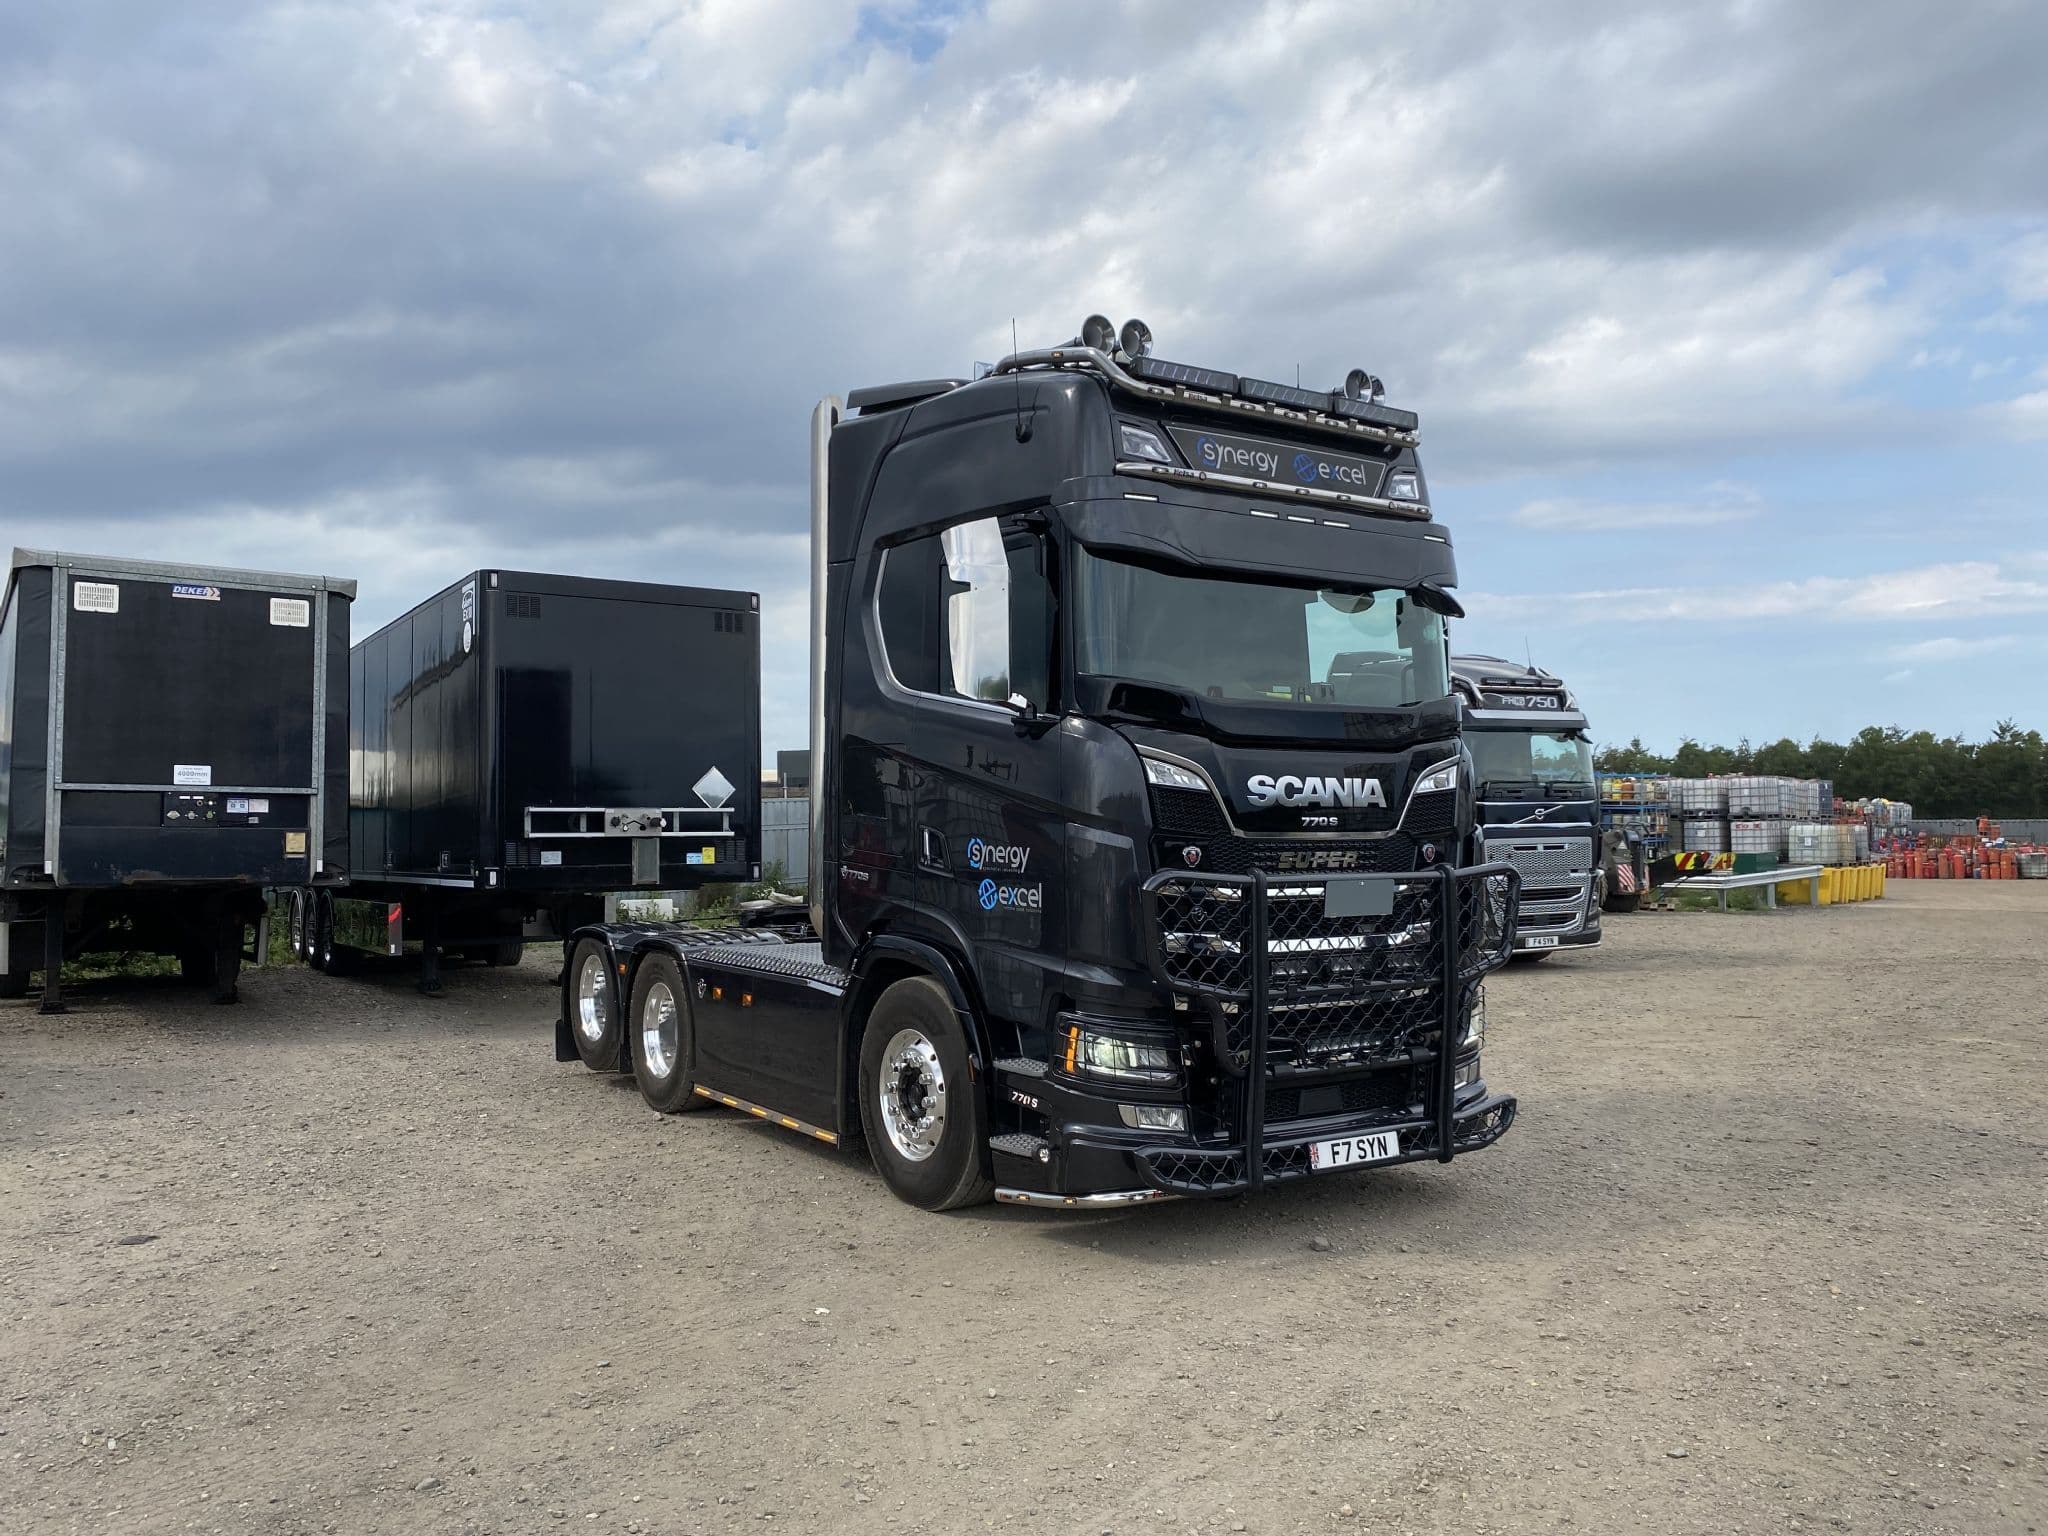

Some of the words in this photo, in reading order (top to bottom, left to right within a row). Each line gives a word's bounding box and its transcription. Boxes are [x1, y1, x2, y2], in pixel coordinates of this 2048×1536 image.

[1203, 441, 1279, 478] synergy
[1318, 461, 1368, 486] excel
[1526, 695, 1558, 709] 750
[1247, 774, 1388, 808] SCANIA
[971, 843, 1031, 874] synergy
[1278, 851, 1359, 869] SUPER
[998, 882, 1042, 908] excel
[1330, 1141, 1352, 1164] F7
[1356, 1135, 1388, 1160] SYN
